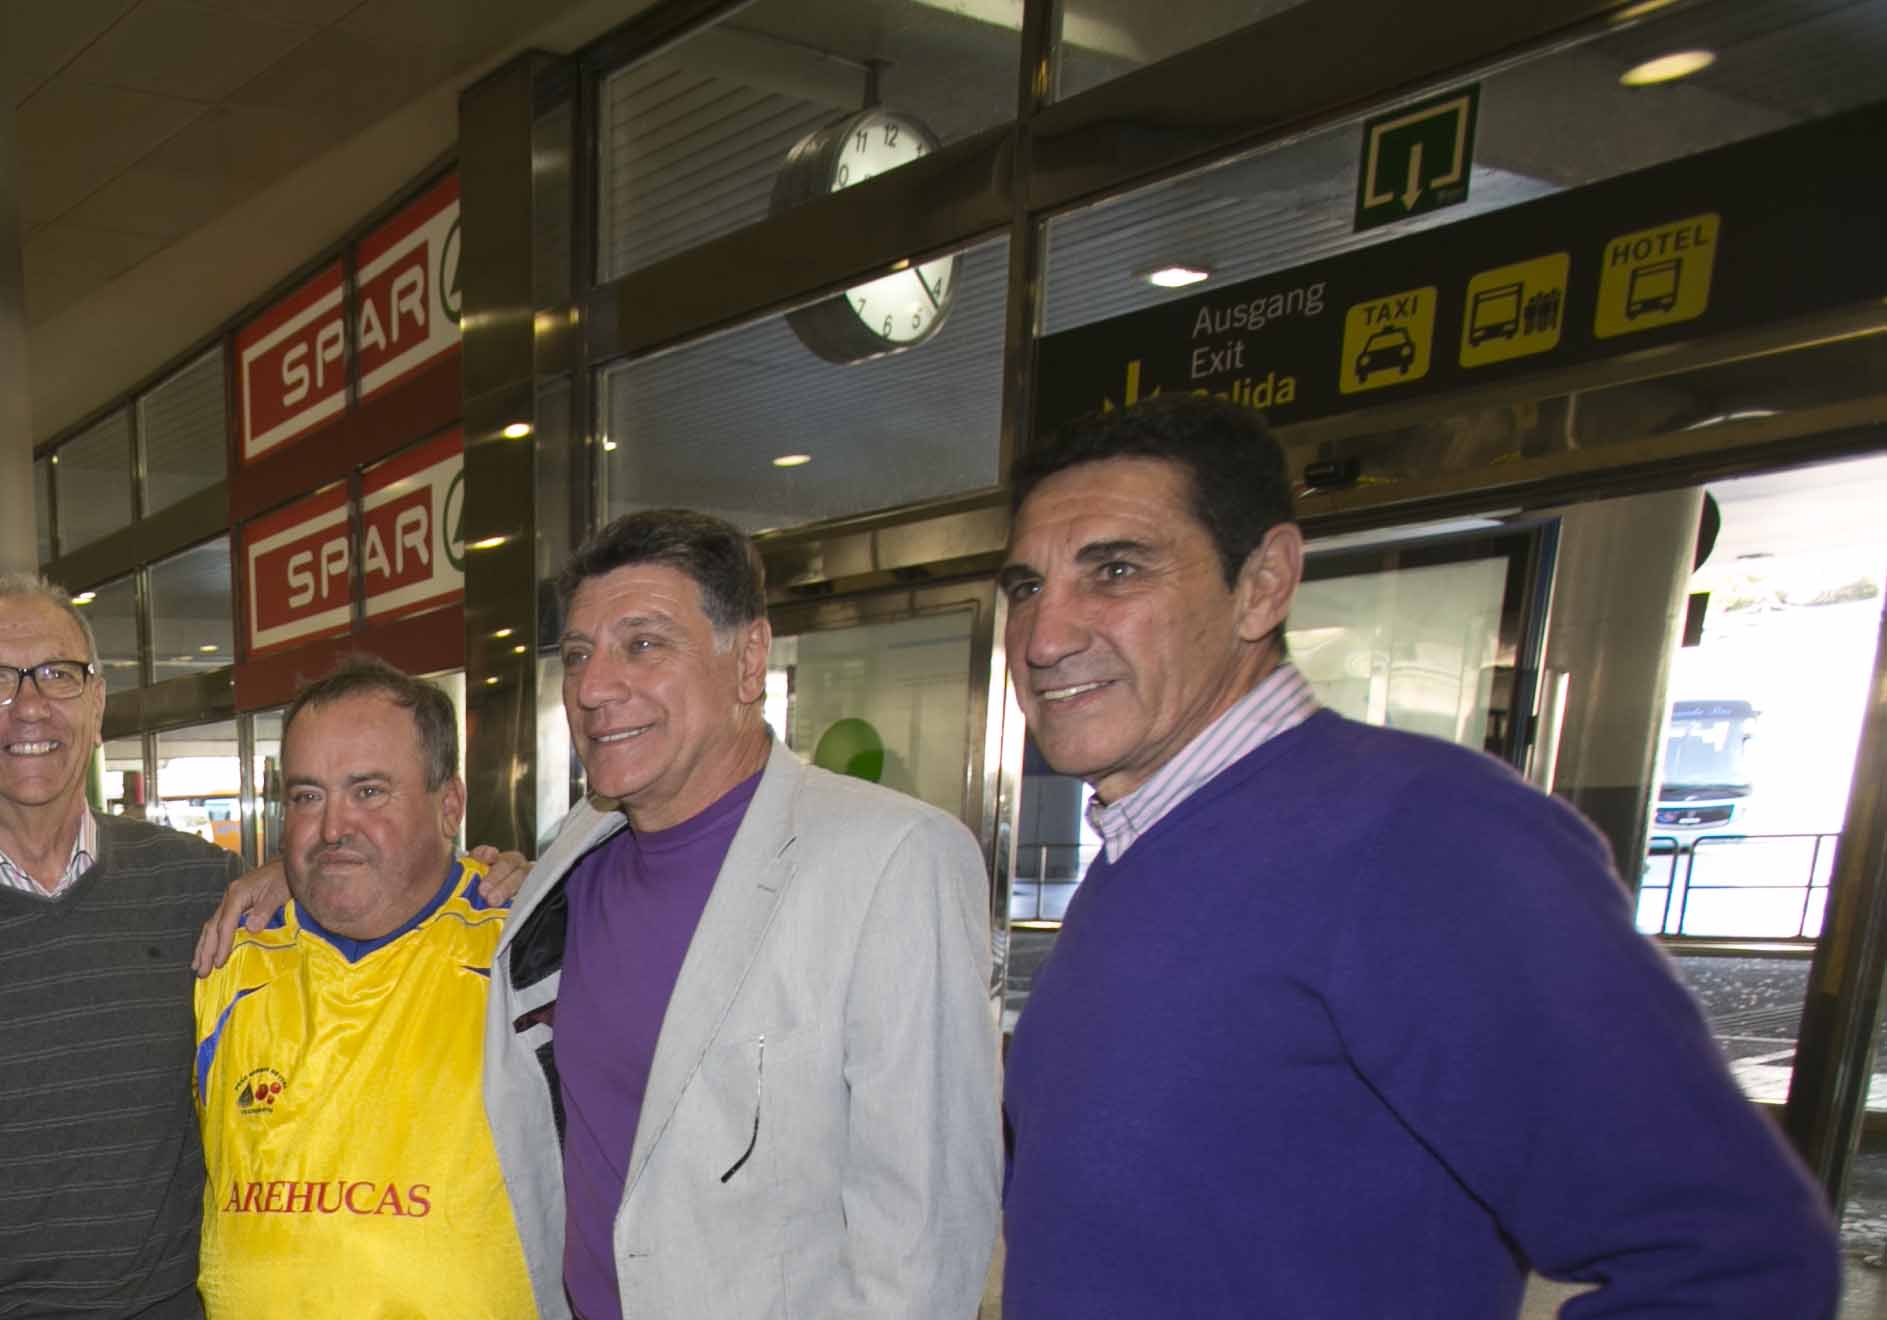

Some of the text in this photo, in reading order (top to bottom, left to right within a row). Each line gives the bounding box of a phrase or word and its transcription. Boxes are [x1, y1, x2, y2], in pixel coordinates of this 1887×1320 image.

[884, 125, 899, 148] 12
[1610, 223, 1710, 268] HOTEL
[1192, 281, 1327, 339] Ausgang
[1364, 295, 1420, 327] TAXI
[282, 263, 425, 406] SPAR
[1191, 340, 1245, 379] Exit
[287, 505, 430, 608] SPAR
[222, 1180, 431, 1217] AREHUCAS
